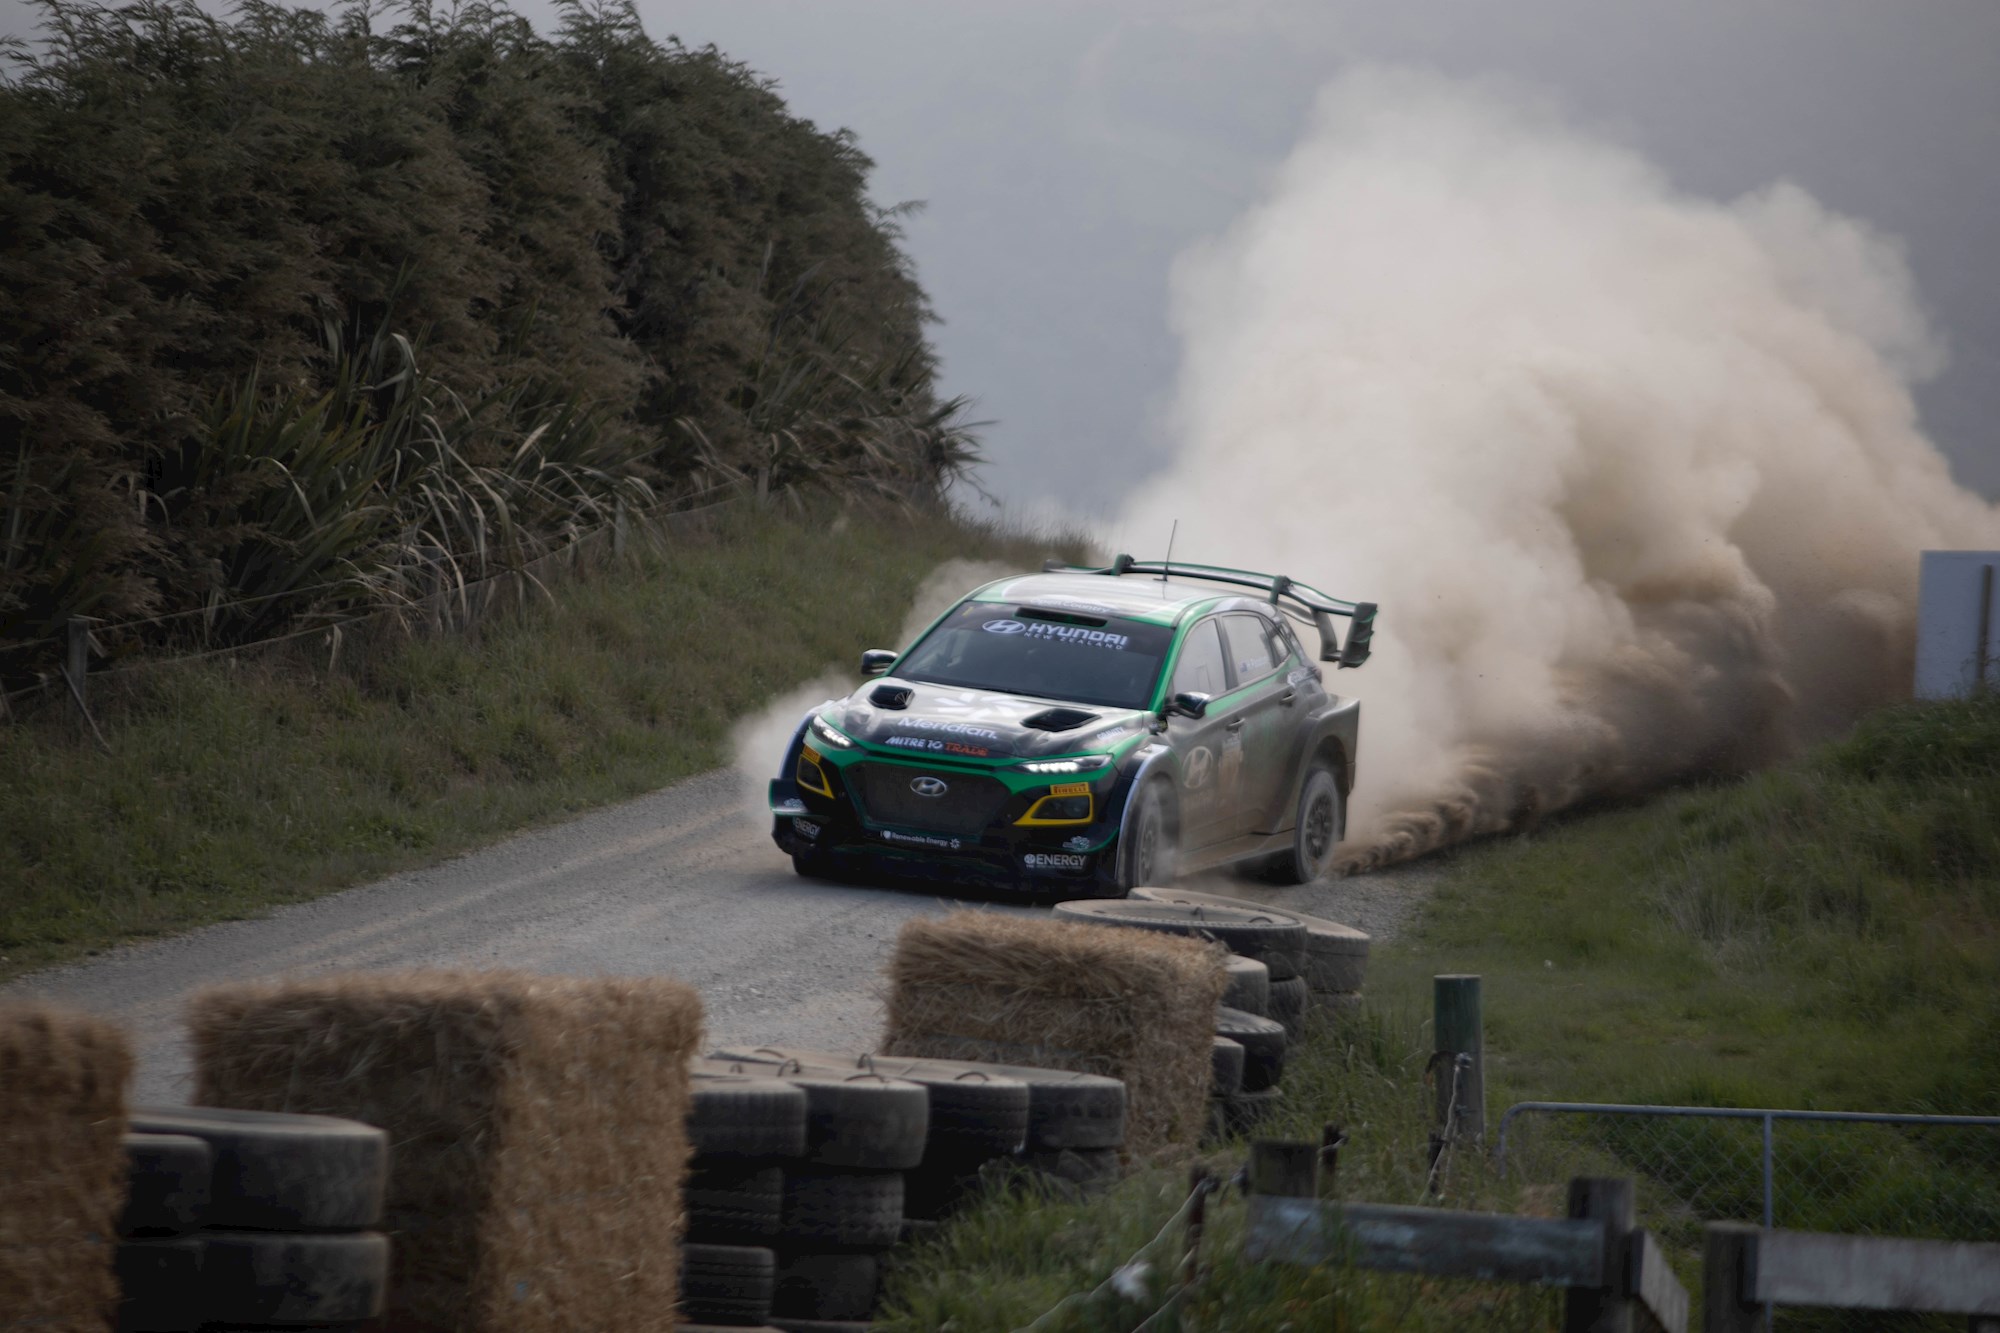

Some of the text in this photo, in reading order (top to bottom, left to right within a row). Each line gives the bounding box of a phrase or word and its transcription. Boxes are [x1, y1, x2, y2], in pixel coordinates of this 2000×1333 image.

[1024, 632, 1123, 650] NEW ZEALAND
[1028, 622, 1128, 645] HYUNDAI
[897, 716, 997, 739] Meridian.
[885, 736, 988, 757] MITRE 10 TRADE
[892, 832, 925, 843] Renewable
[926, 836, 948, 847] Energy
[1036, 854, 1087, 866] ENERGY
